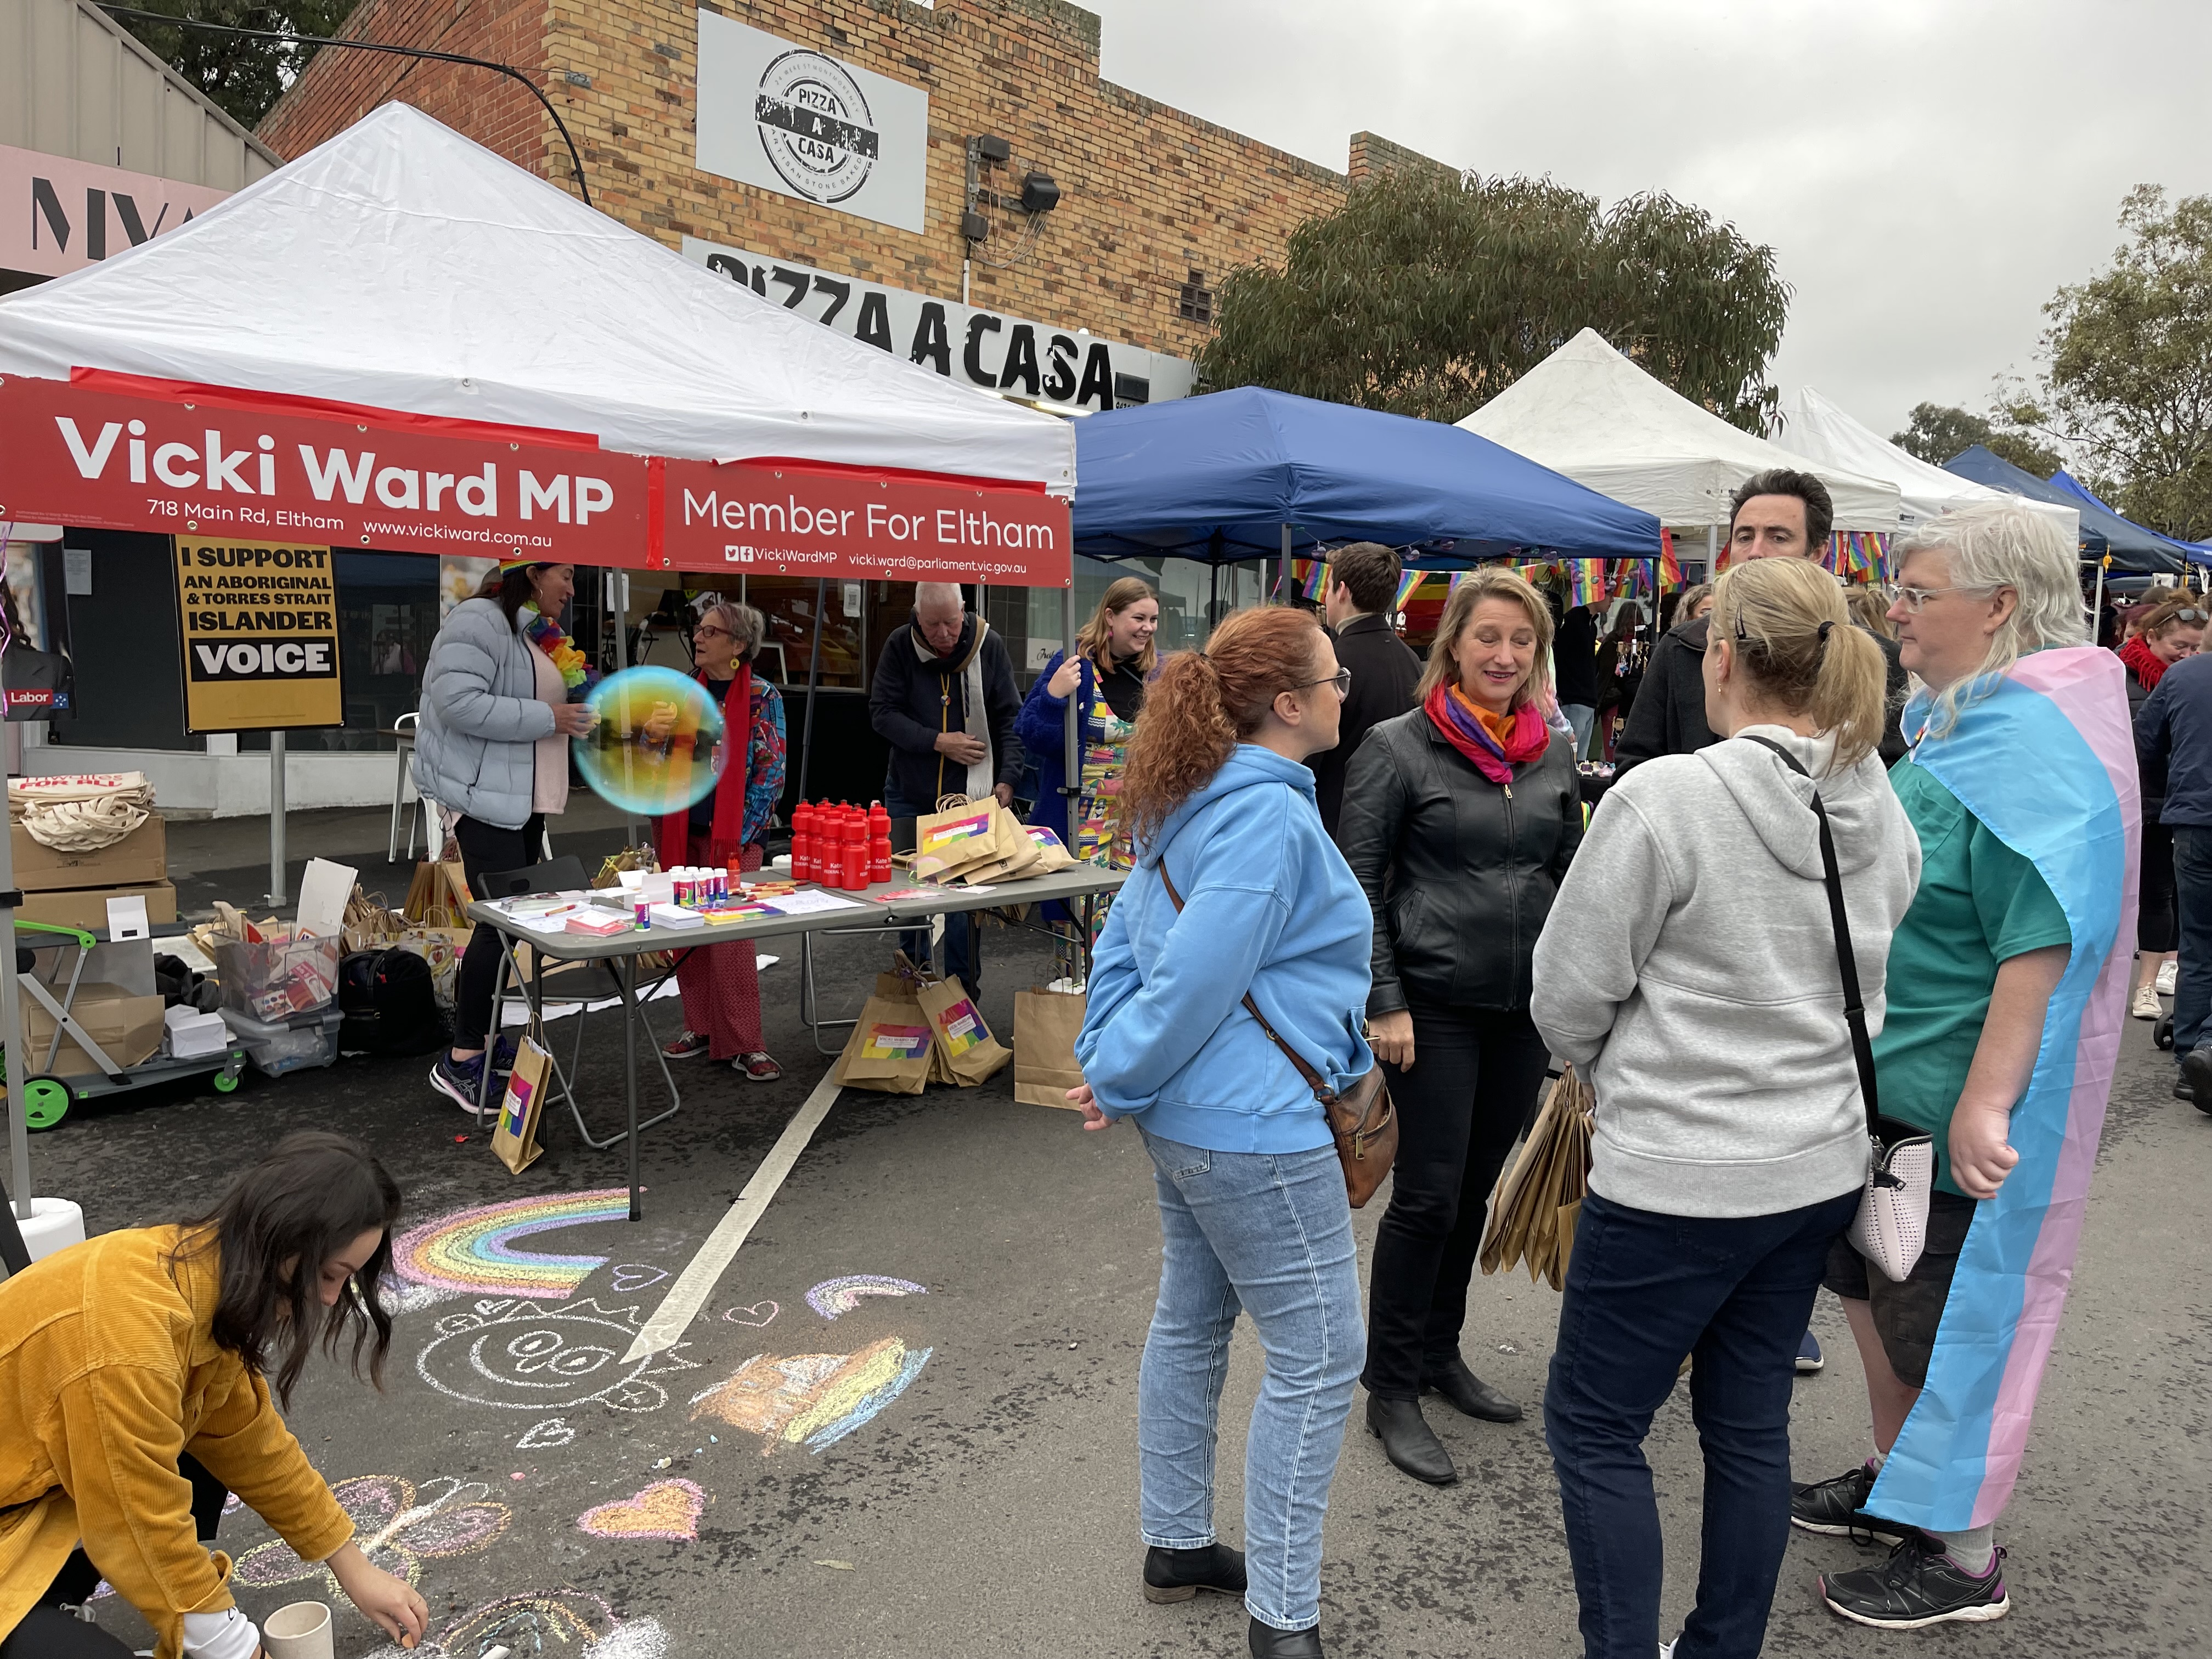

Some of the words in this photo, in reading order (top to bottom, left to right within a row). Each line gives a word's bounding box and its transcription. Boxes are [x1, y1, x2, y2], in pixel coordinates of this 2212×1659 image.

[799, 88, 837, 115] PIZZA
[812, 65, 859, 112] MONTMORENCY
[811, 116, 824, 136] A
[771, 128, 802, 179] ARTISAN
[805, 178, 837, 190] STONE
[840, 157, 862, 185] BAKED
[798, 137, 834, 163] CASA
[909, 302, 951, 376] A
[963, 313, 1114, 410] CASA
[54, 416, 276, 496] Vicki
[297, 444, 497, 517] Ward
[518, 469, 614, 525] MP
[146, 499, 178, 516] 718
[184, 502, 234, 522] Main
[240, 507, 270, 527] Rd,
[275, 510, 345, 531] Eltham
[684, 487, 855, 536] Member
[866, 503, 926, 541] For
[936, 508, 1054, 550] Eltham
[363, 521, 552, 548] www.vickiward.com.au
[181, 546, 191, 566] I
[197, 546, 328, 568] SUPPORT
[754, 548, 838, 563] VickiWardMP
[848, 552, 1027, 575] vicki.ward@parliament.vic.gov.au
[184, 575, 213, 589] AN
[216, 575, 332, 590] ABORIGINAL
[186, 592, 200, 605] &
[202, 593, 270, 605] TORRES
[274, 593, 331, 605] STRAIT
[188, 611, 332, 631] ISLANDER
[195, 643, 330, 674] VOICE
[10, 692, 49, 703] Labor
